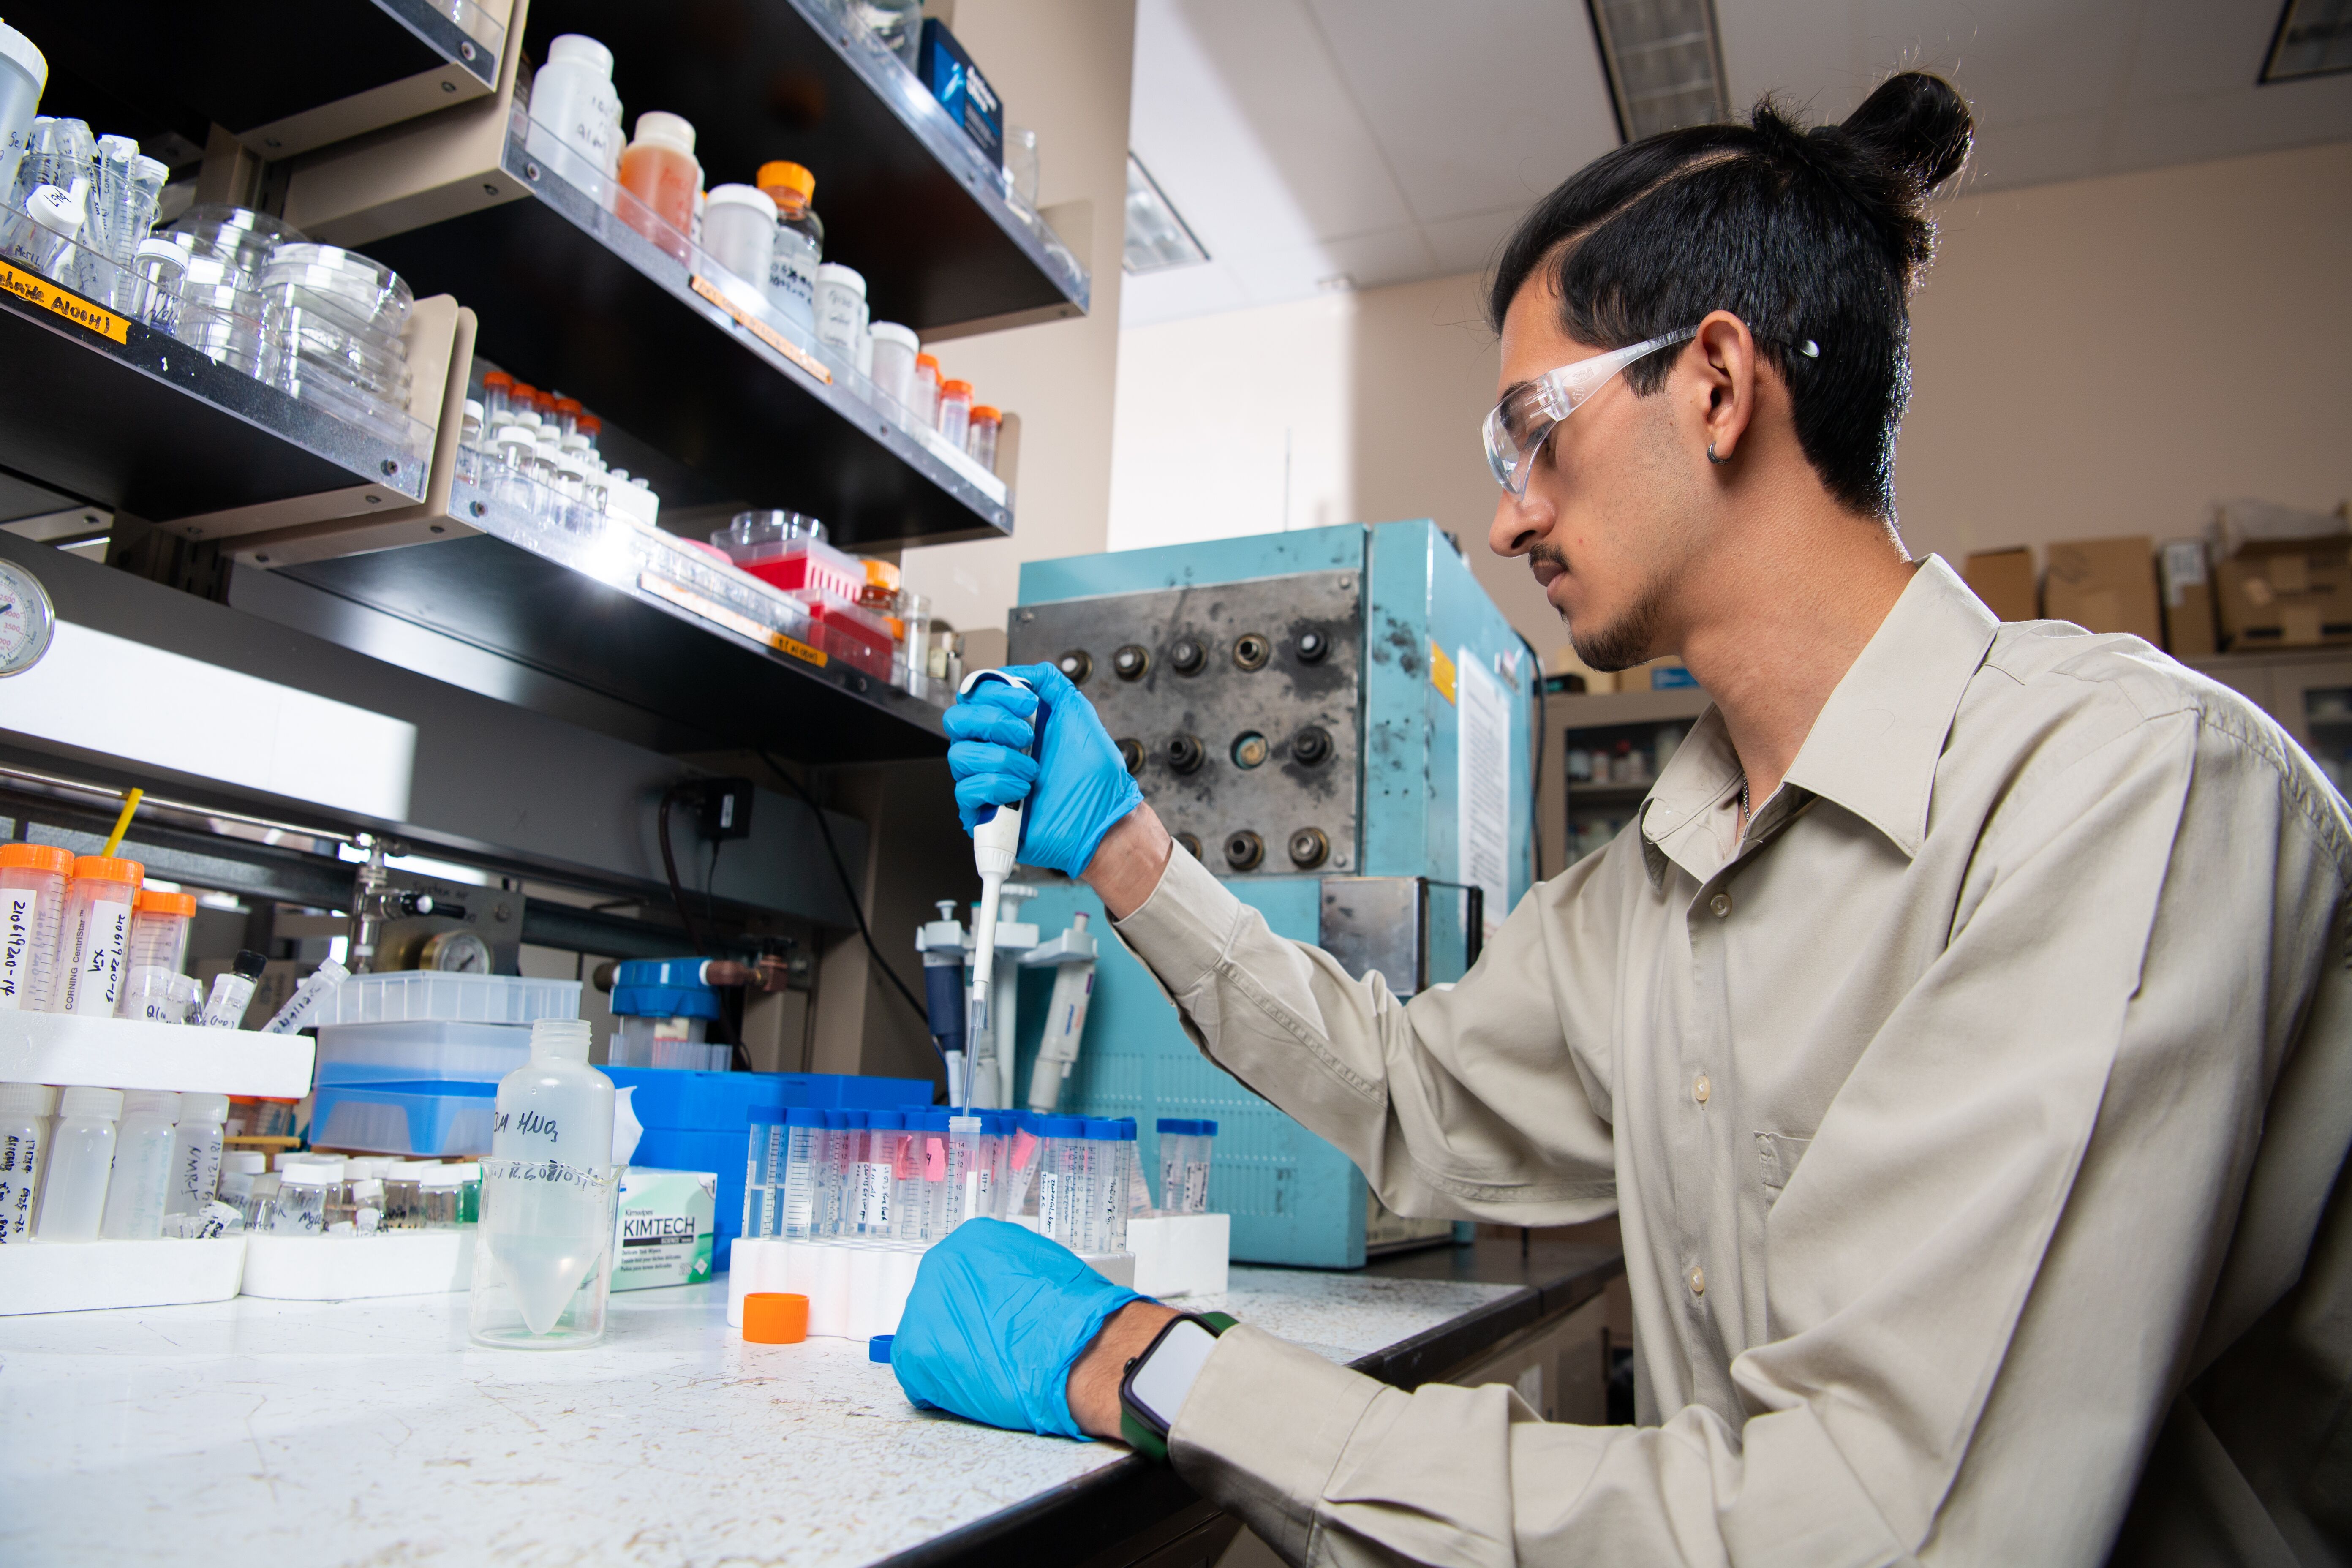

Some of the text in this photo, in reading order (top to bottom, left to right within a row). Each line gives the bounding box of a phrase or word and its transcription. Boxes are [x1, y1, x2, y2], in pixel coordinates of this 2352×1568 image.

[4, 622, 20, 632] 3500
[65, 966, 79, 1010] CORNING
[624, 1217, 695, 1237] KIMTECH
